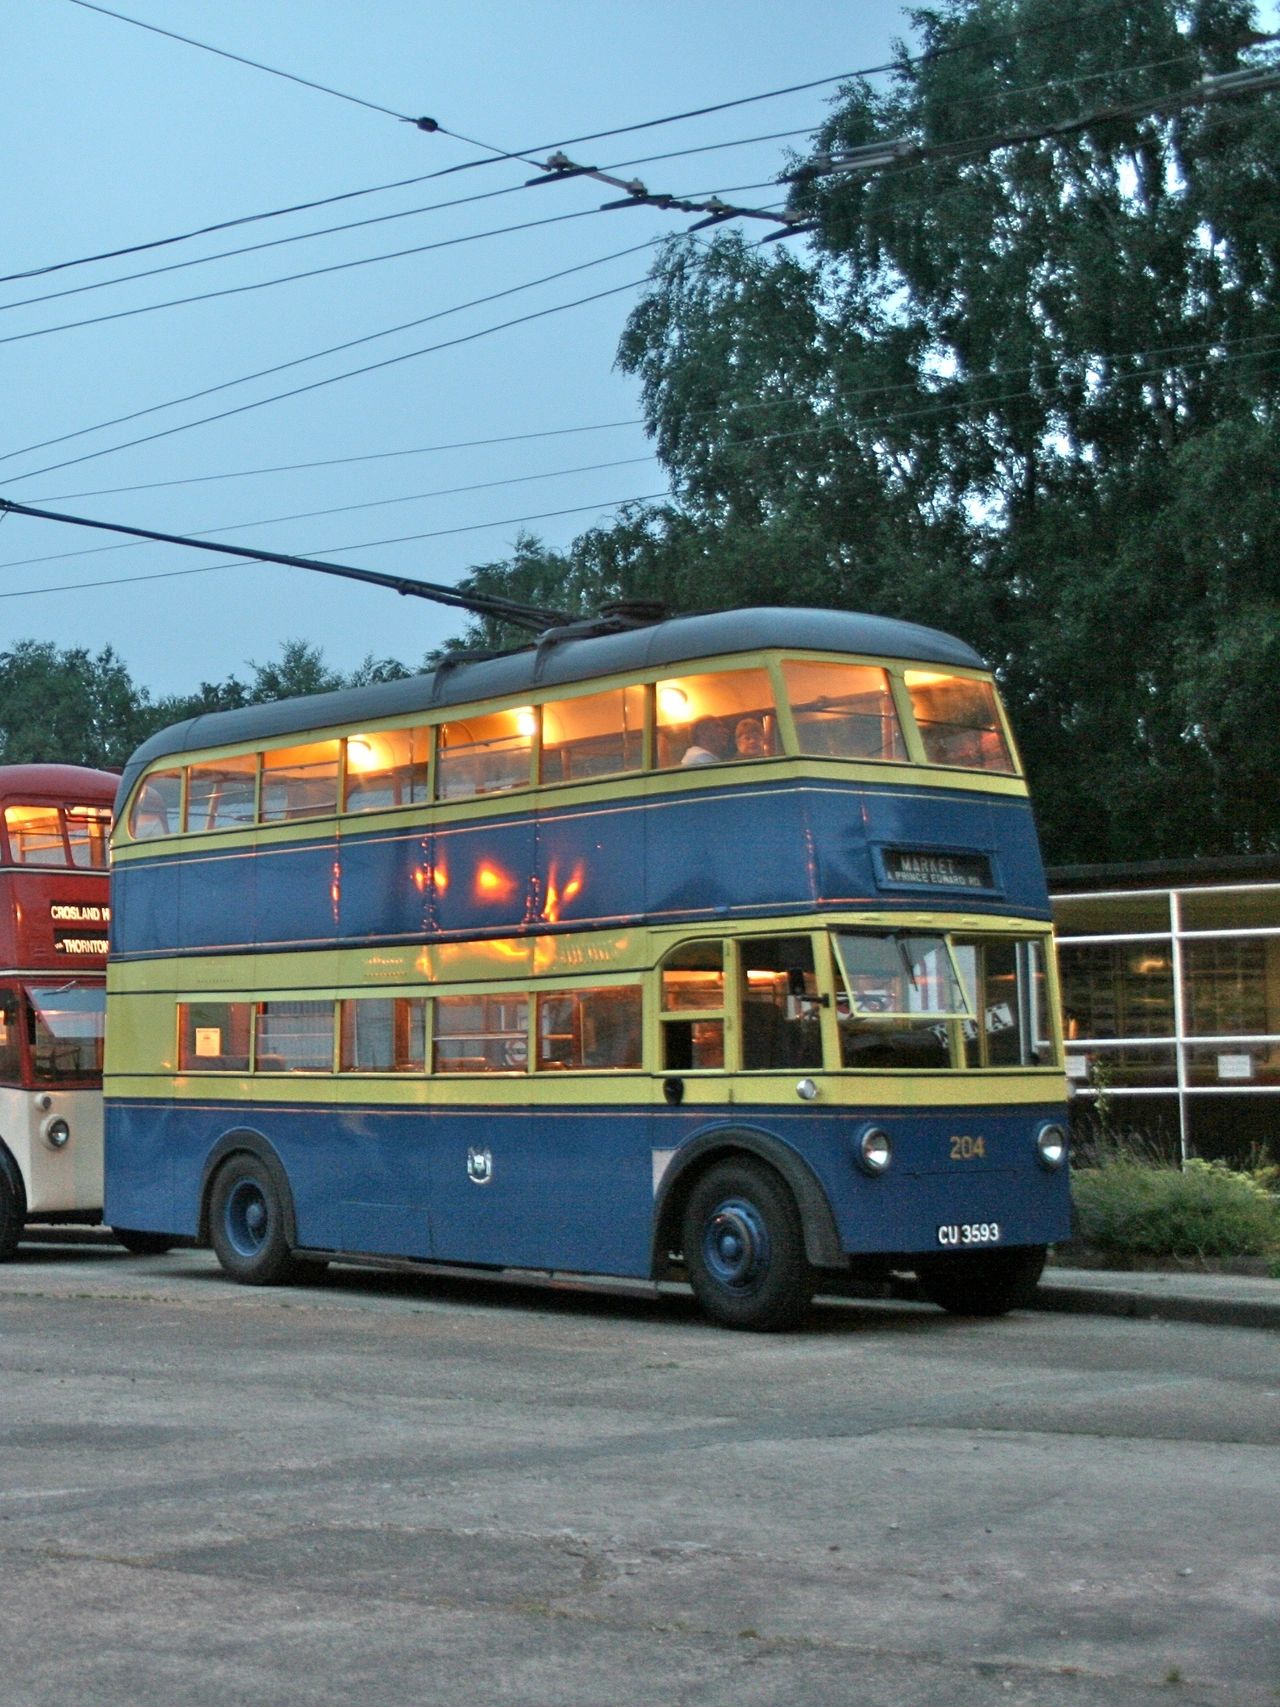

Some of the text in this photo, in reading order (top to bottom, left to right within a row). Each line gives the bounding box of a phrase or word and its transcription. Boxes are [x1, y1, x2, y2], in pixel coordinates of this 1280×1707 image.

[900, 855, 955, 874] MARKET
[895, 871, 929, 883] PRINCE
[930, 874, 967, 886] EDWARD
[51, 906, 101, 921] CROSLAND
[949, 1135, 986, 1159] 204
[938, 1222, 999, 1244] CU 3593
